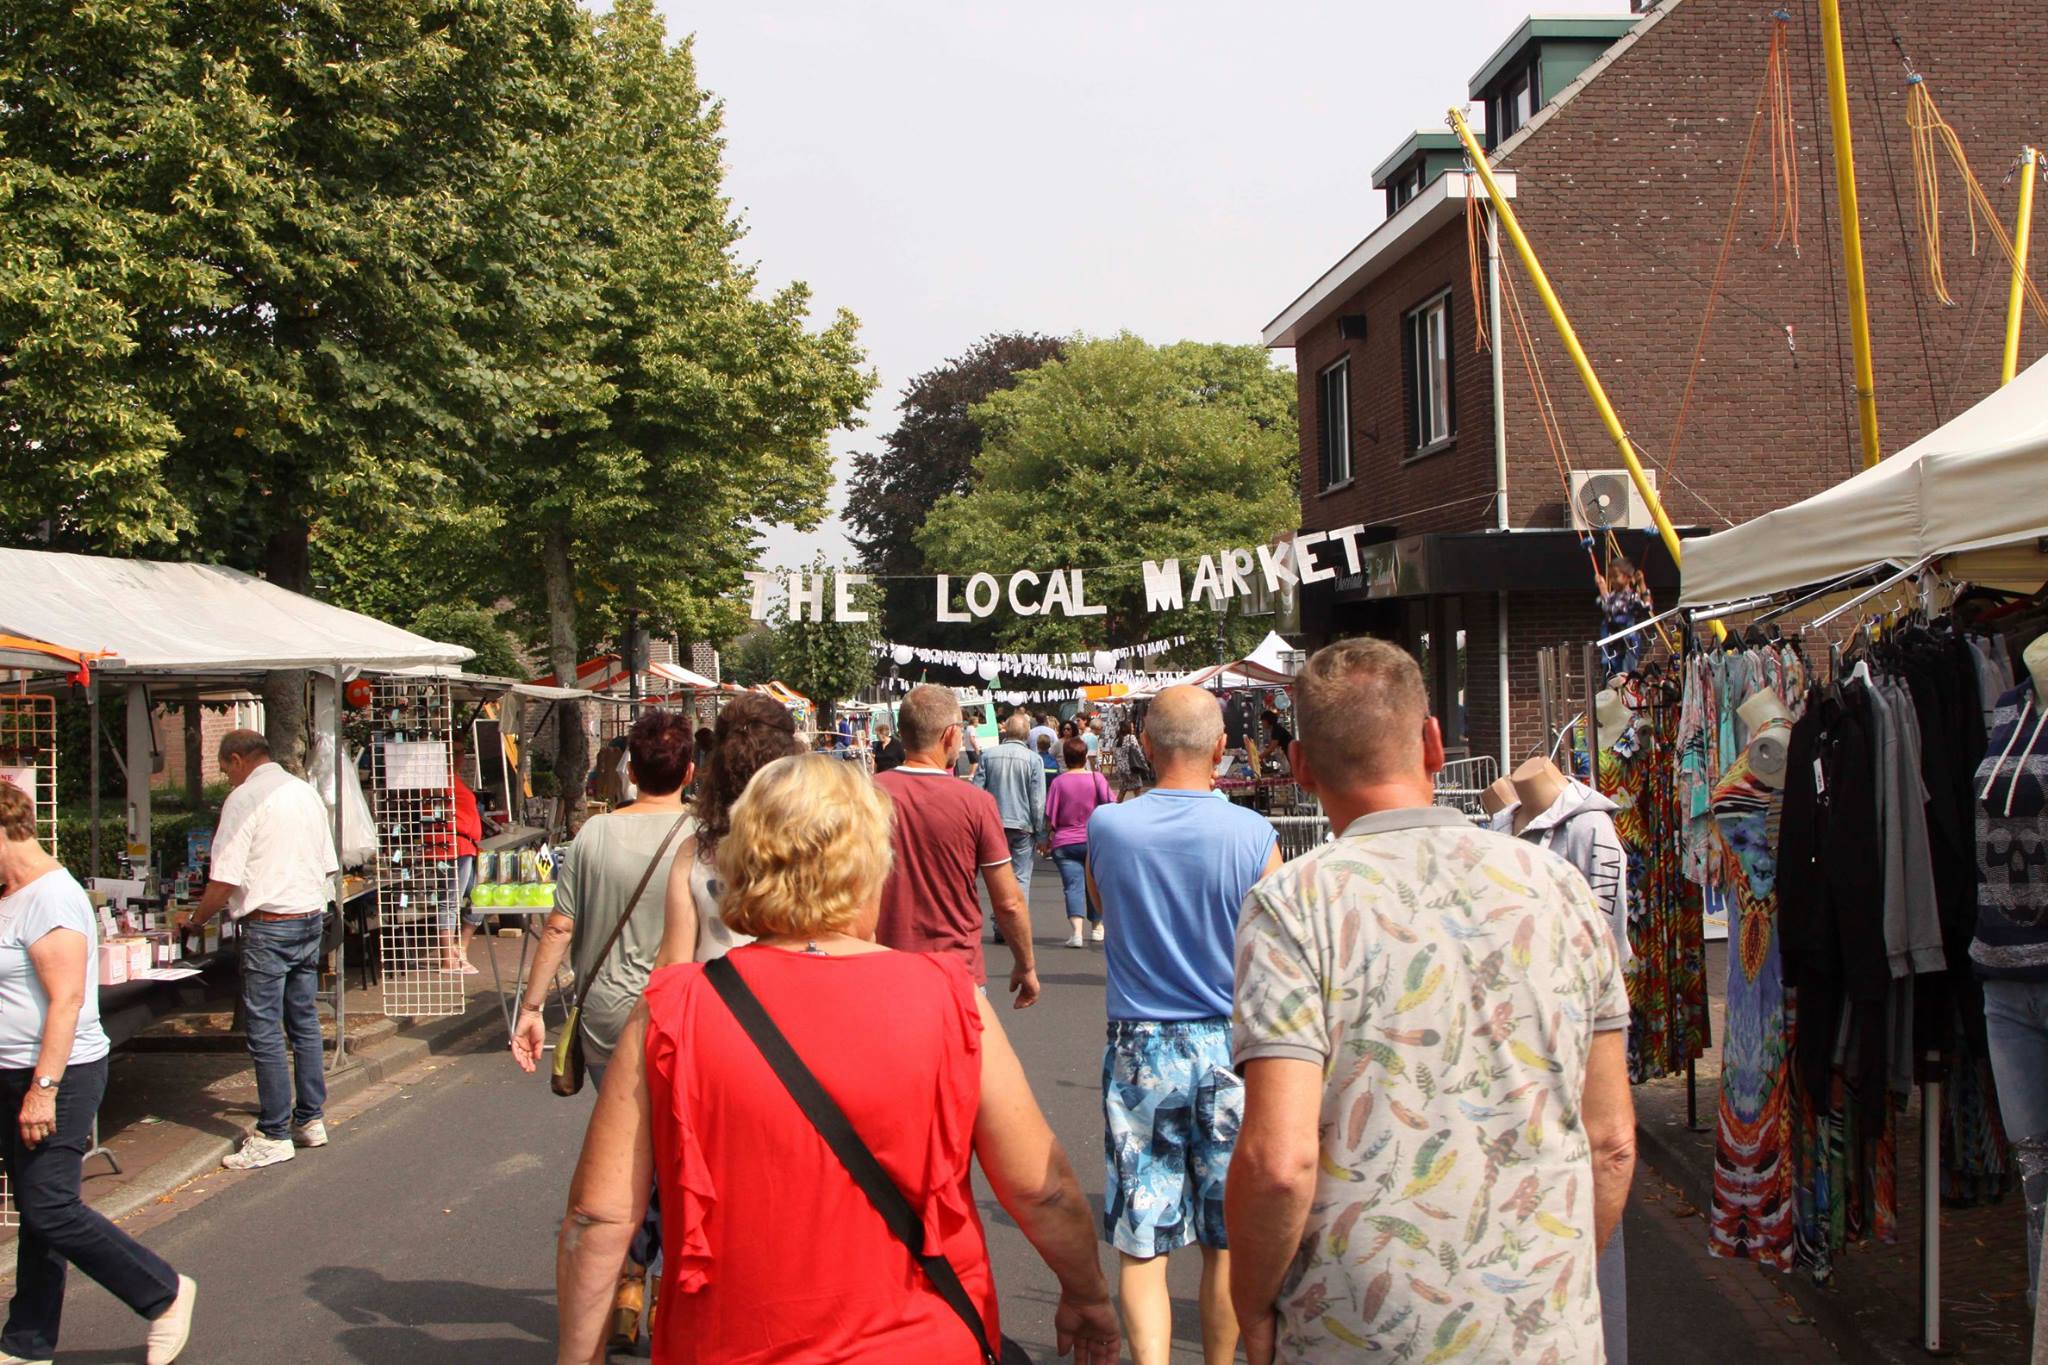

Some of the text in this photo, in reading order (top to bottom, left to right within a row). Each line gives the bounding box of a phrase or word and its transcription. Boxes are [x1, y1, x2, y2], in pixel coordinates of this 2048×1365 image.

[744, 571, 869, 623] THE
[937, 569, 1107, 623] LOCAL
[1142, 524, 1365, 612] MARKET
